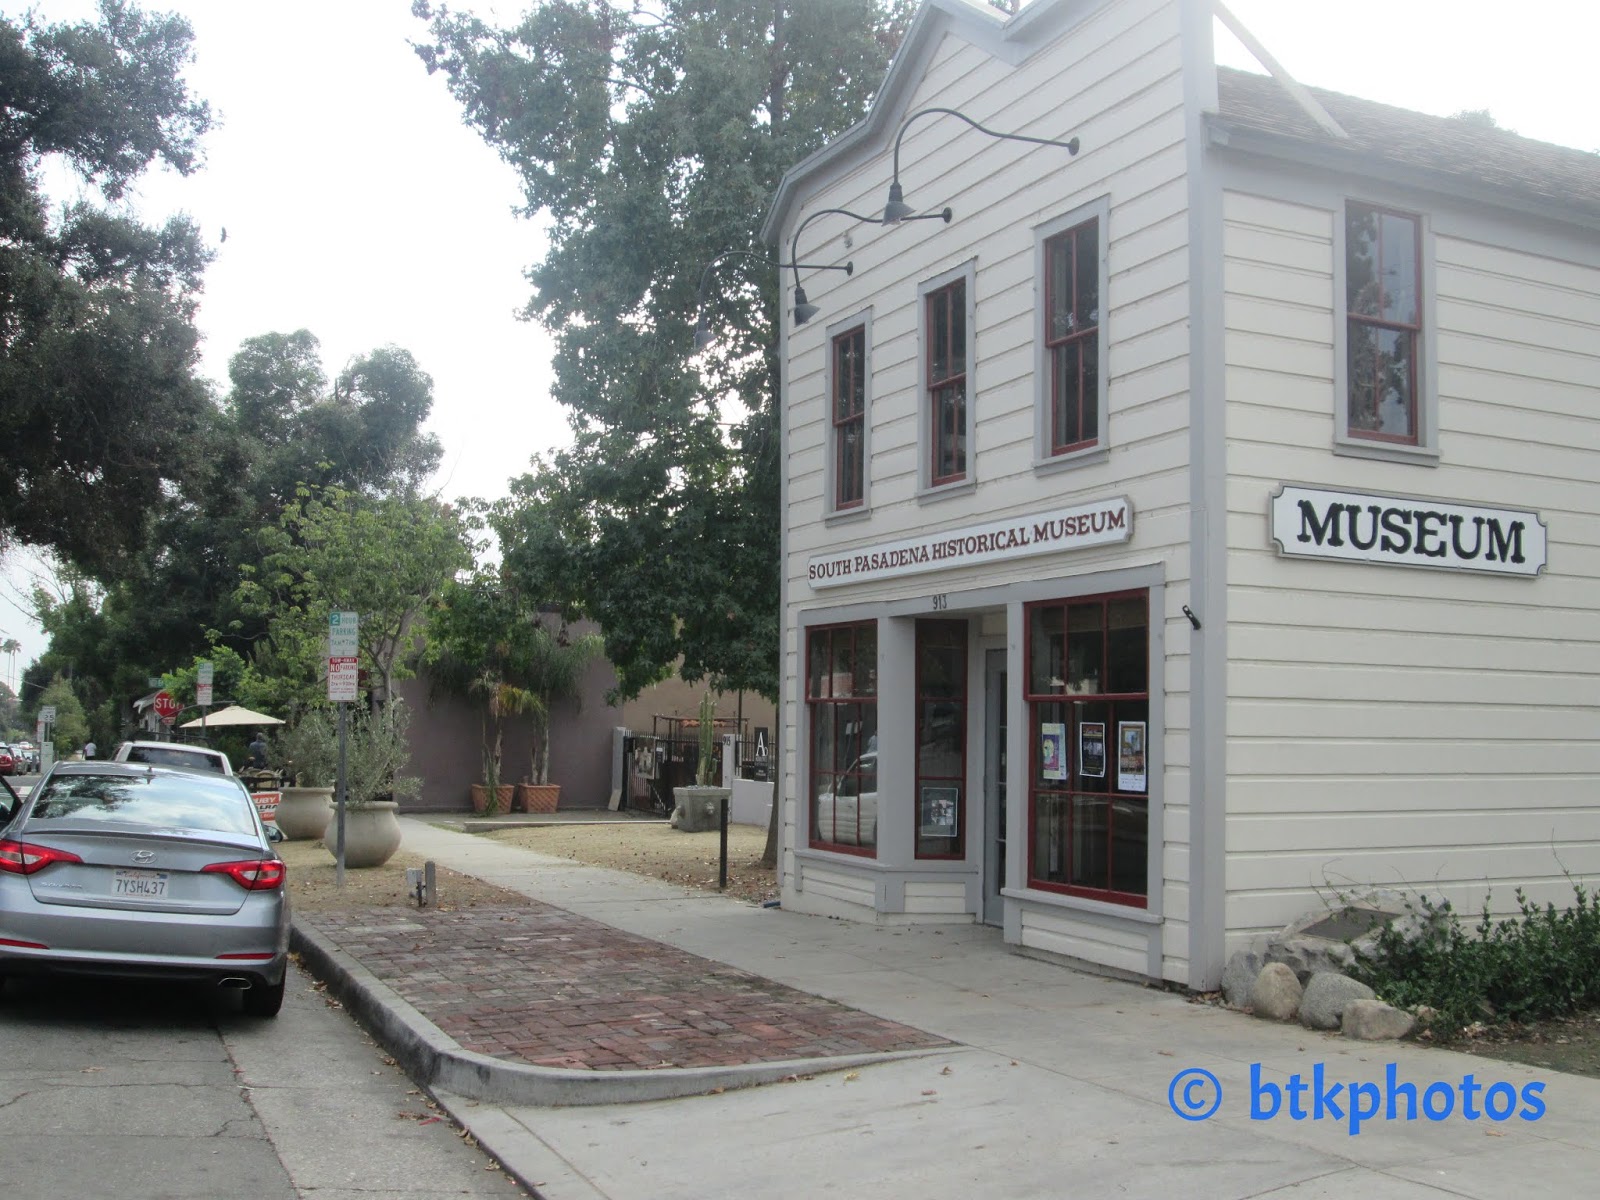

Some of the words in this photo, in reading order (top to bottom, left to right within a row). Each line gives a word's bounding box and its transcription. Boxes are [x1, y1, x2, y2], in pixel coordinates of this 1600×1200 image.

[1297, 499, 1526, 564] MUSEUM
[809, 559, 852, 580] SOUTH
[854, 545, 930, 572] PASADENA
[932, 527, 1030, 560] HISTORICAL
[1033, 507, 1126, 543] MUSEUM
[932, 594, 948, 610] 913
[331, 614, 339, 625] 2
[341, 616, 357, 625] HOUR
[332, 628, 356, 636] PARKING
[330, 663, 340, 672] NO
[44, 714, 55, 722] 25
[254, 796, 277, 804] UBY
[115, 878, 166, 896] 7YSH437
